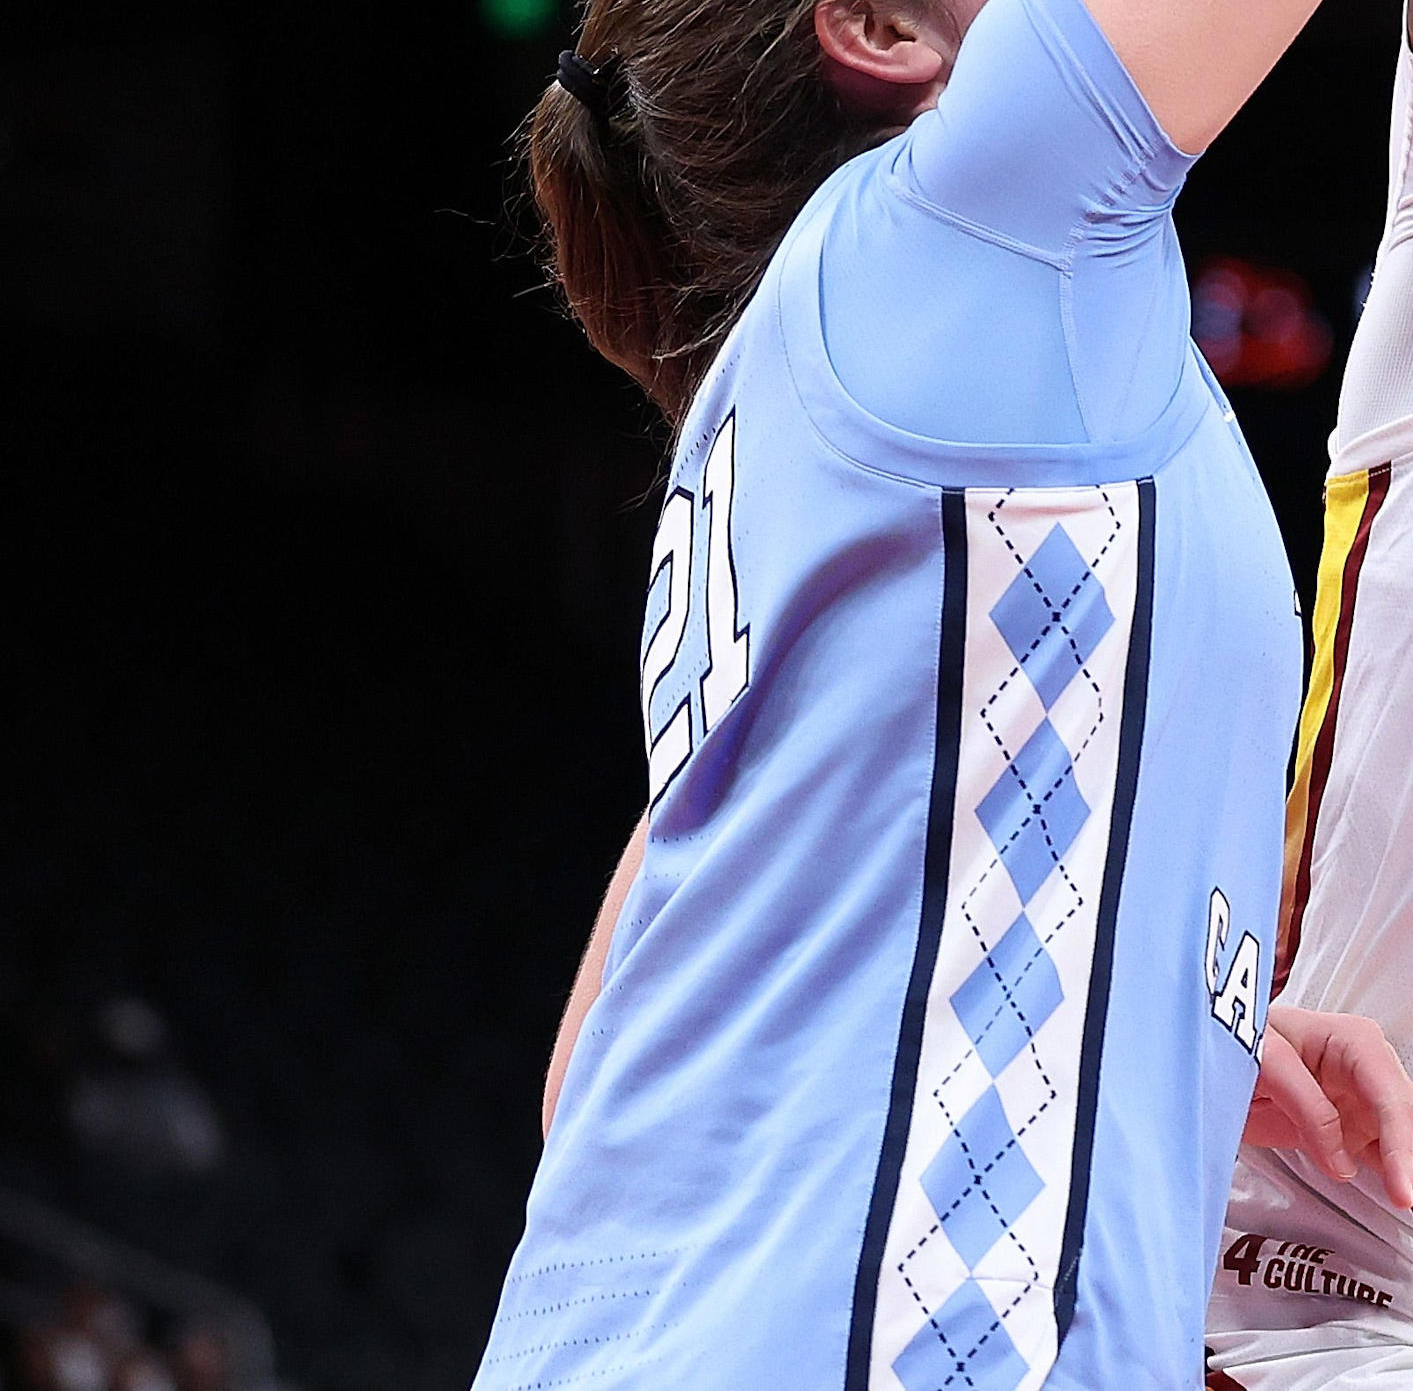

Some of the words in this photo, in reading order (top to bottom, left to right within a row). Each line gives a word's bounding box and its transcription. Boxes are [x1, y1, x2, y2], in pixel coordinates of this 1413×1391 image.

[640, 404, 750, 823] 21
[1204, 886, 1264, 1070] CA
[1223, 1233, 1267, 1286] 4
[1263, 1258, 1393, 1309] CULTURE
